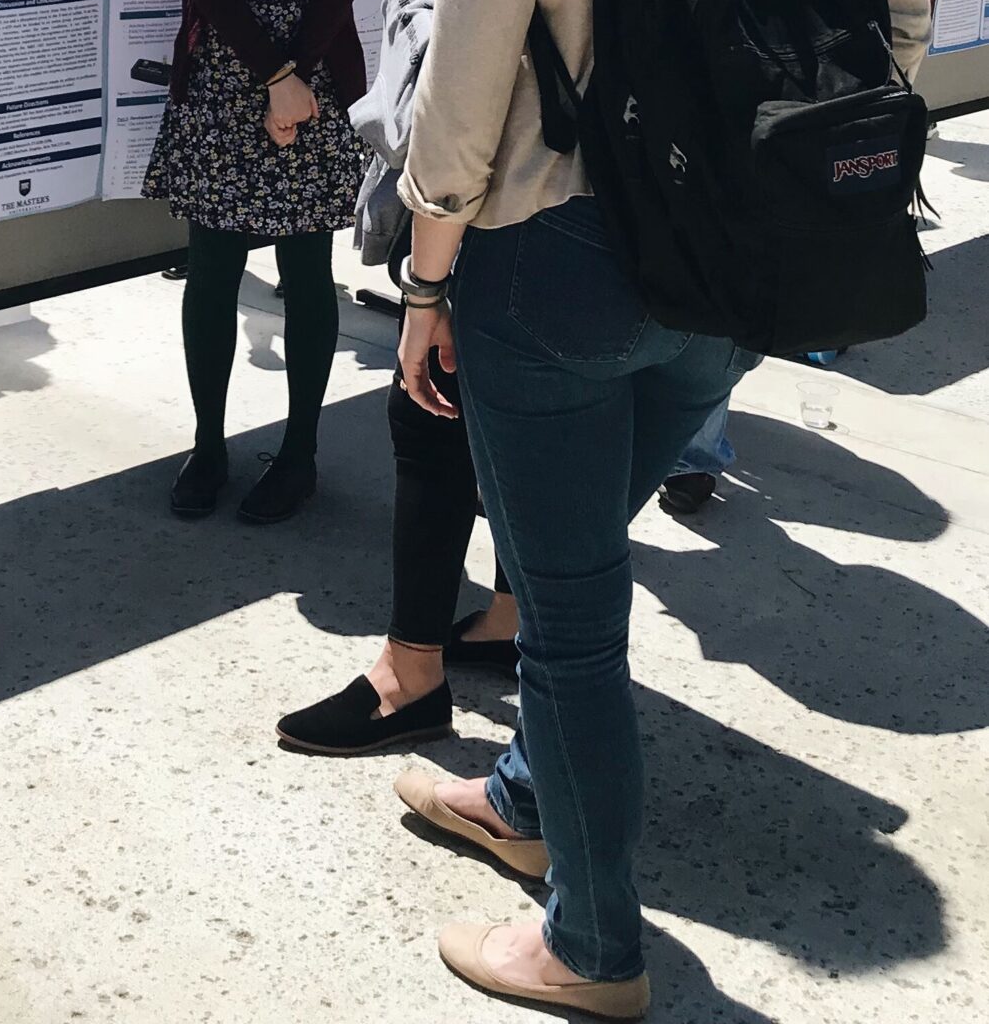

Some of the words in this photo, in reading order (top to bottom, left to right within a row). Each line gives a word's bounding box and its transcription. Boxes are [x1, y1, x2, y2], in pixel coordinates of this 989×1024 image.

[24, 100, 49, 108] Directions
[13, 130, 41, 139] References
[833, 150, 898, 182] JANSPORT
[2, 202, 15, 212] THE
[16, 196, 50, 208] MASTER'S
